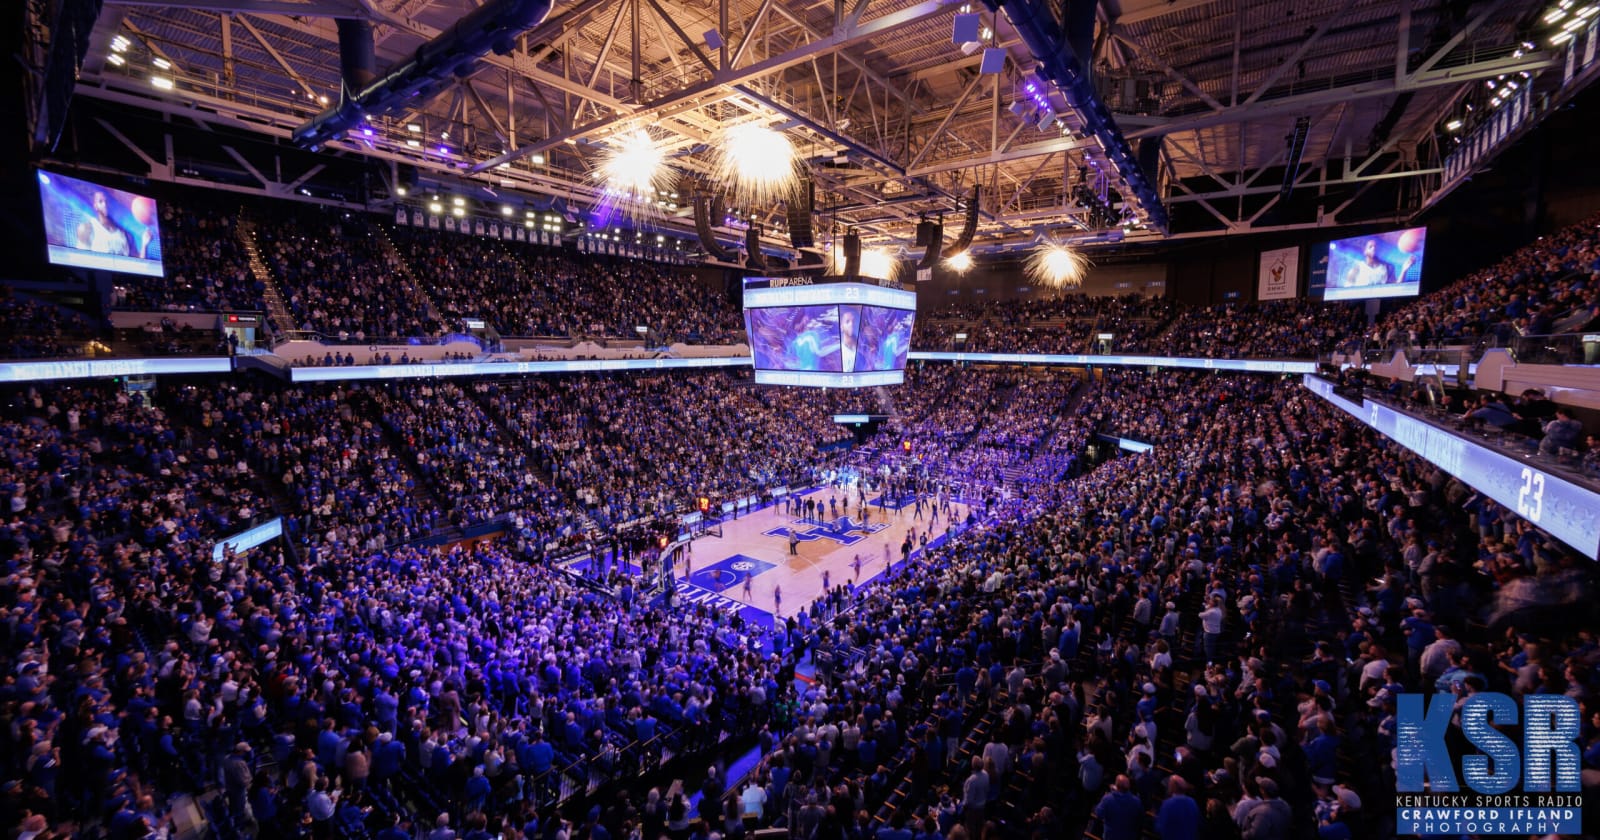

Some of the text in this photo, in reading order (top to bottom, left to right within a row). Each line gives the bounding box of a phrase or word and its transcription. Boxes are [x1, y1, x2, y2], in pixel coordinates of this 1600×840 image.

[769, 276, 813, 288] RUPP ARENA
[846, 287, 859, 298] 23
[1519, 469, 1545, 522] 23
